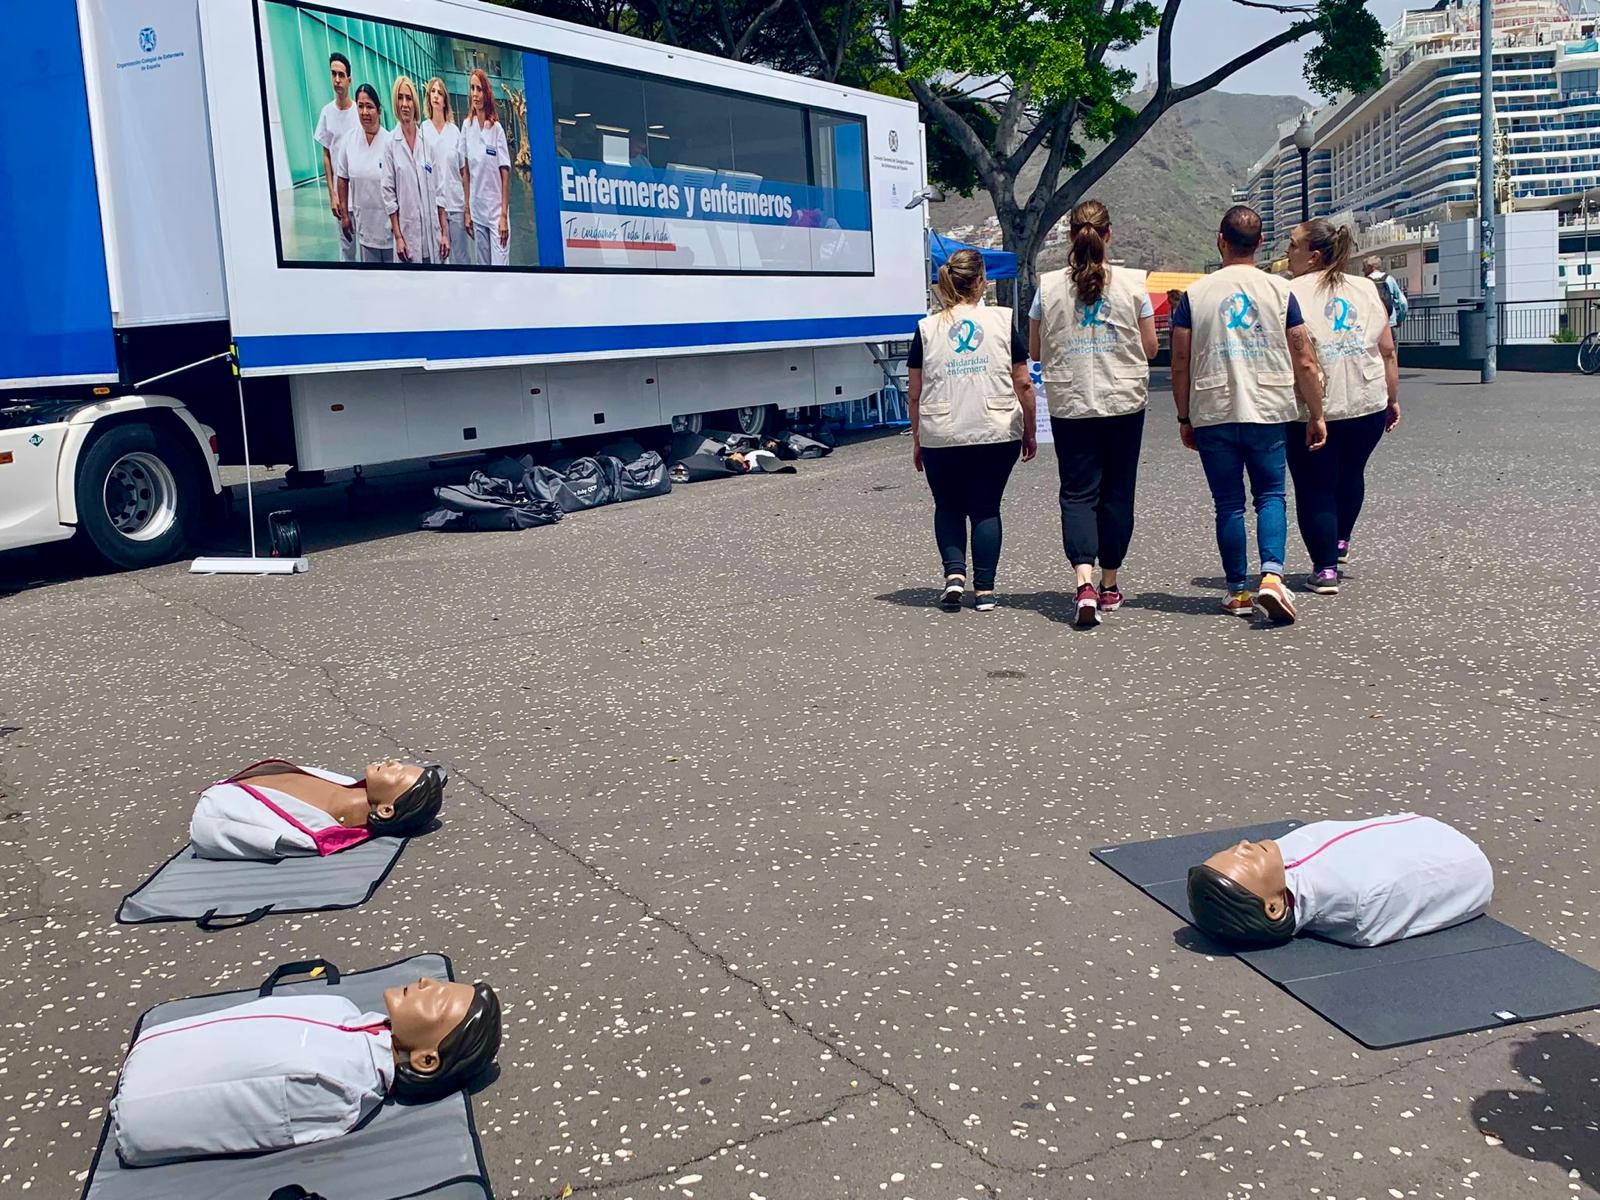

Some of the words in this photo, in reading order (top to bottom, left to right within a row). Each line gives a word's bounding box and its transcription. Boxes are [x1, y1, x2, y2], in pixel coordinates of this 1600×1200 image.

[560, 165, 680, 211] Enfermeras
[683, 186, 696, 218] y
[700, 183, 793, 219] enfermeros
[565, 217, 578, 240] Te
[620, 220, 640, 243] Toda
[946, 365, 987, 376] enfermera
